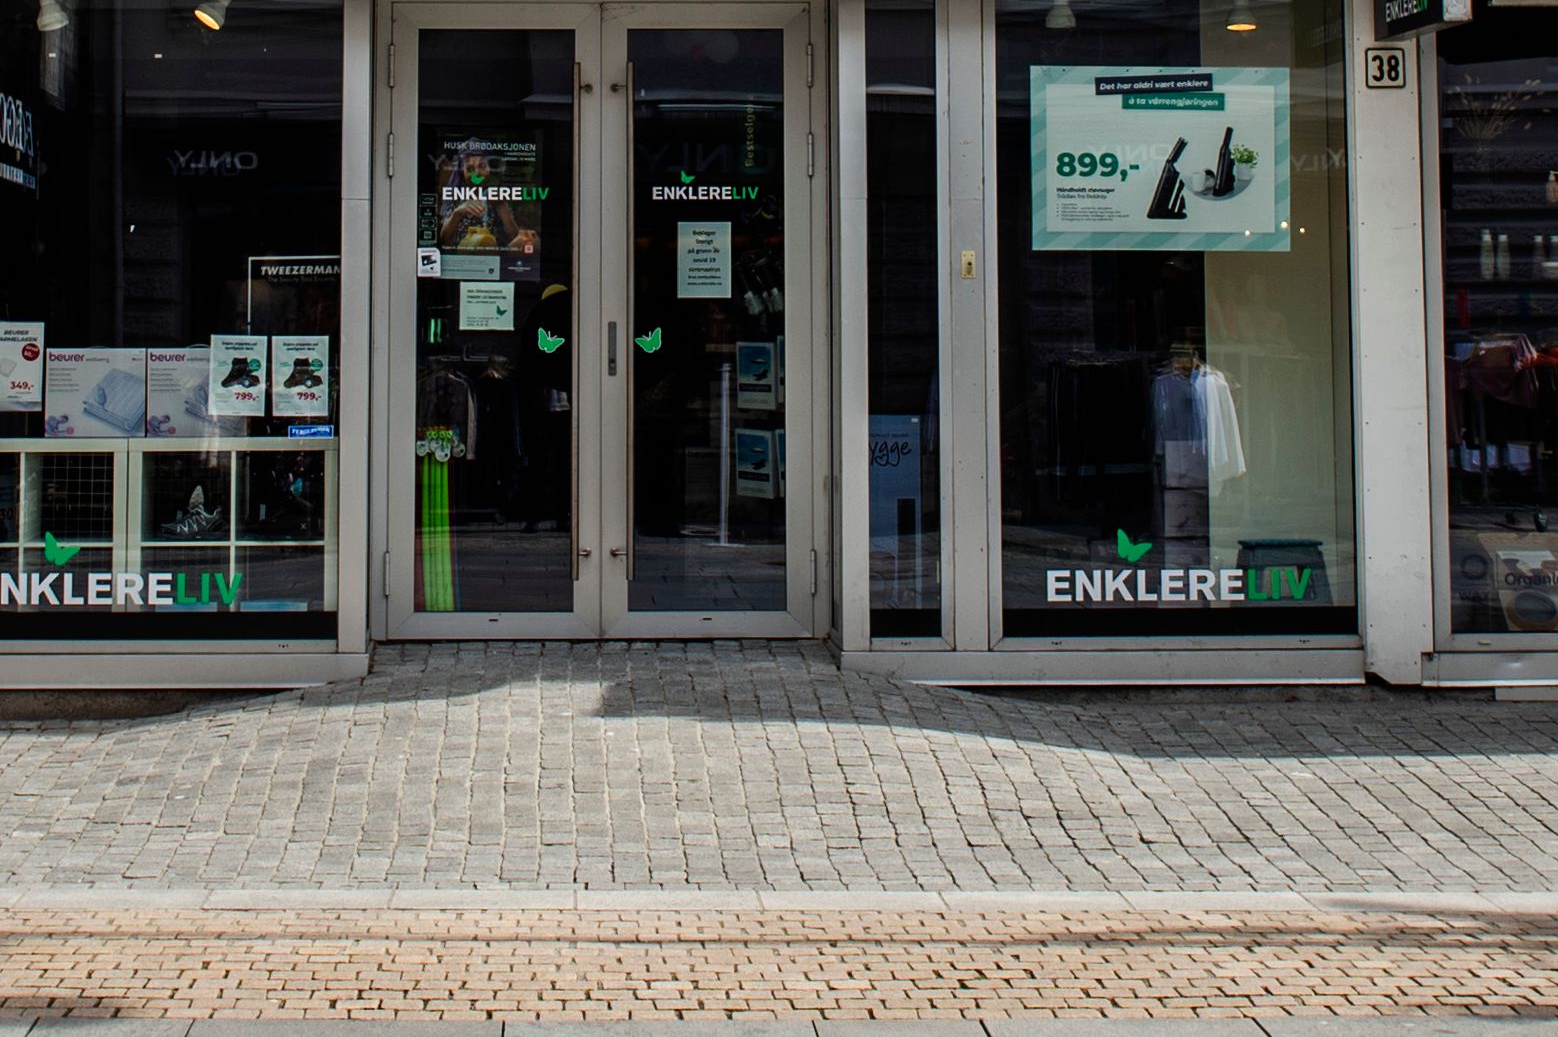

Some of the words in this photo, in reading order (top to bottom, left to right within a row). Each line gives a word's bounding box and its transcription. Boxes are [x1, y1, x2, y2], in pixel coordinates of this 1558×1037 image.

[1371, 54, 1401, 82] 38
[1099, 82, 1115, 91] Det
[1116, 81, 1133, 90] har
[1133, 80, 1154, 90] aldri
[1154, 80, 1175, 89] vært
[1176, 79, 1209, 88] enklere
[1136, 97, 1147, 105] ta
[443, 140, 468, 150] HUSK
[1056, 152, 1140, 182] 899,-
[442, 186, 550, 201] ENKLERELIV
[651, 185, 760, 201] ENKLERELIV
[260, 264, 341, 276] TWEEZERMAN
[49, 351, 85, 362] beurer
[150, 352, 186, 362] beurer
[10, 381, 35, 391] 349,-
[234, 392, 260, 401] 799,-
[297, 392, 322, 401] 799,-
[0, 571, 244, 606] NKLERELIV
[1046, 567, 1313, 602] ENKLERELIV
